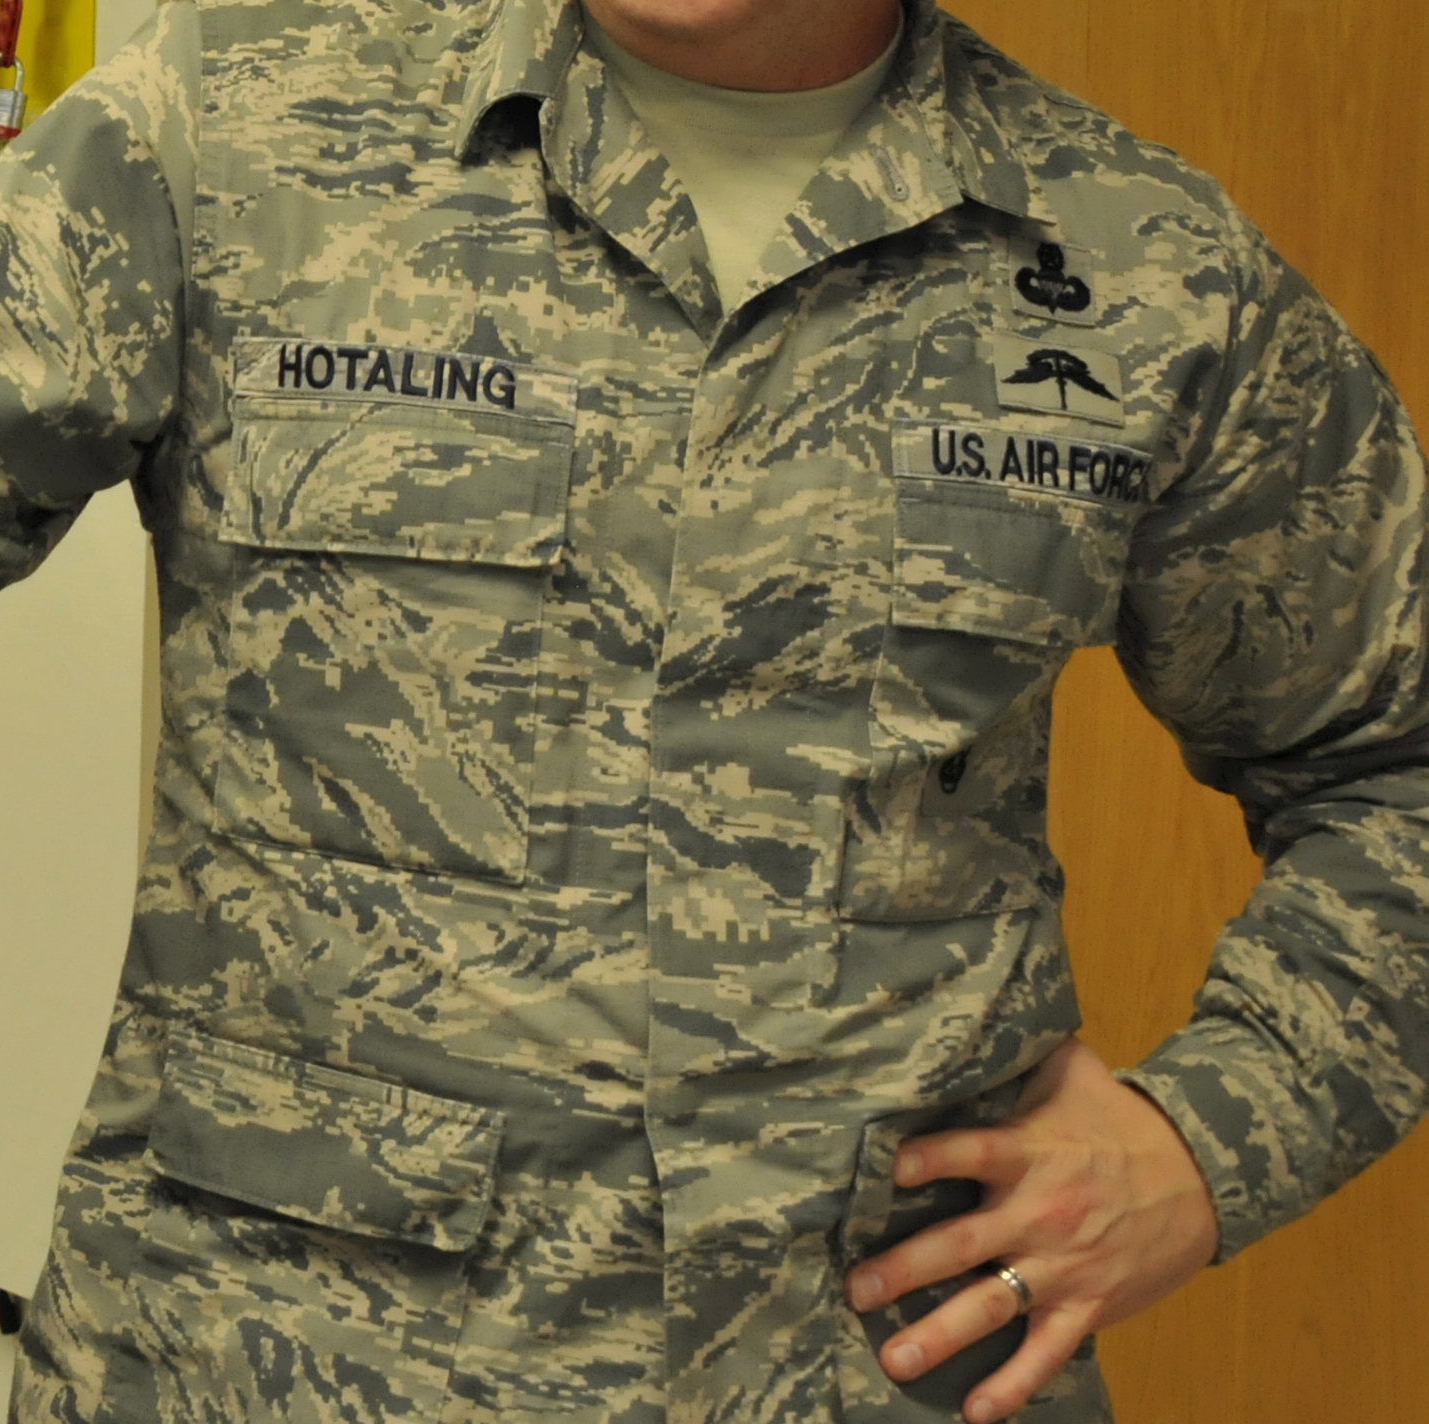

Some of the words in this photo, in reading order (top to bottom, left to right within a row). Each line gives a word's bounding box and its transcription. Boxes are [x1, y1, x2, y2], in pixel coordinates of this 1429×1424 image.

[278, 343, 516, 410] HOTALING
[932, 428, 991, 480] U.S.
[999, 437, 1060, 487] AIR
[1068, 445, 1150, 502] FORC
